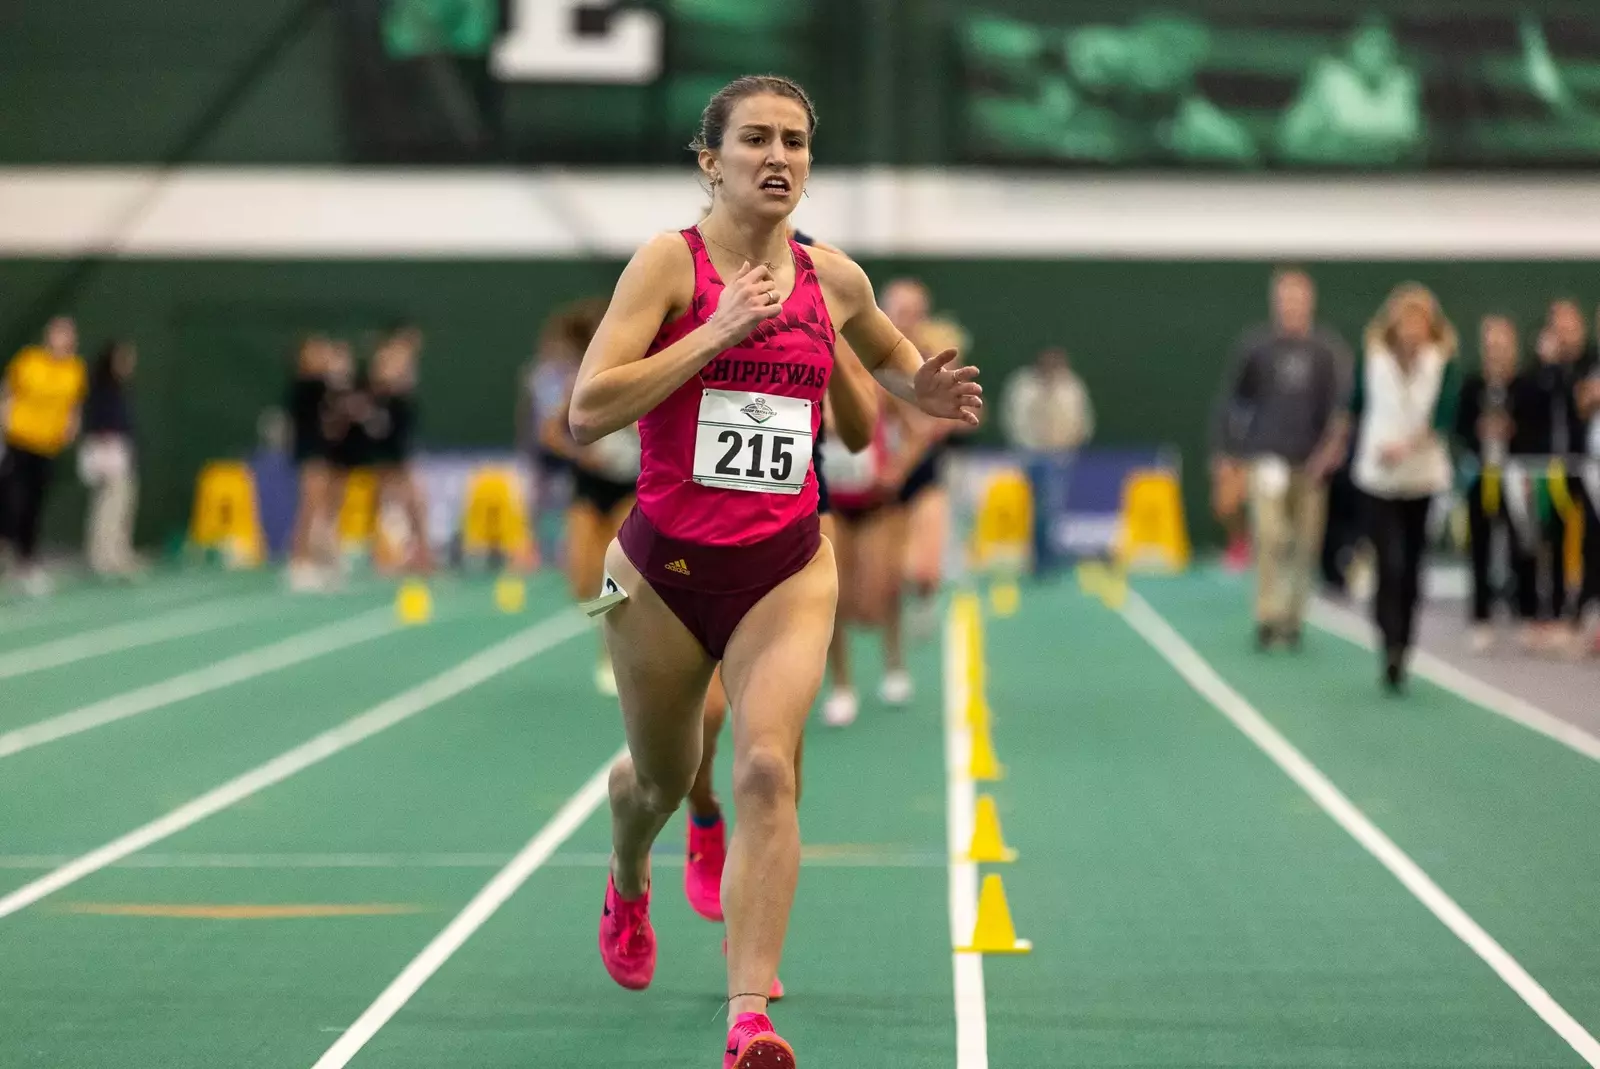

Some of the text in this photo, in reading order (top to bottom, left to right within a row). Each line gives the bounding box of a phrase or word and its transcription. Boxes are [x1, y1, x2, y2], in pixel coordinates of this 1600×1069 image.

[699, 360, 826, 389] CHIPPEWAS
[715, 431, 794, 480] 215
[664, 564, 690, 576] adidas
